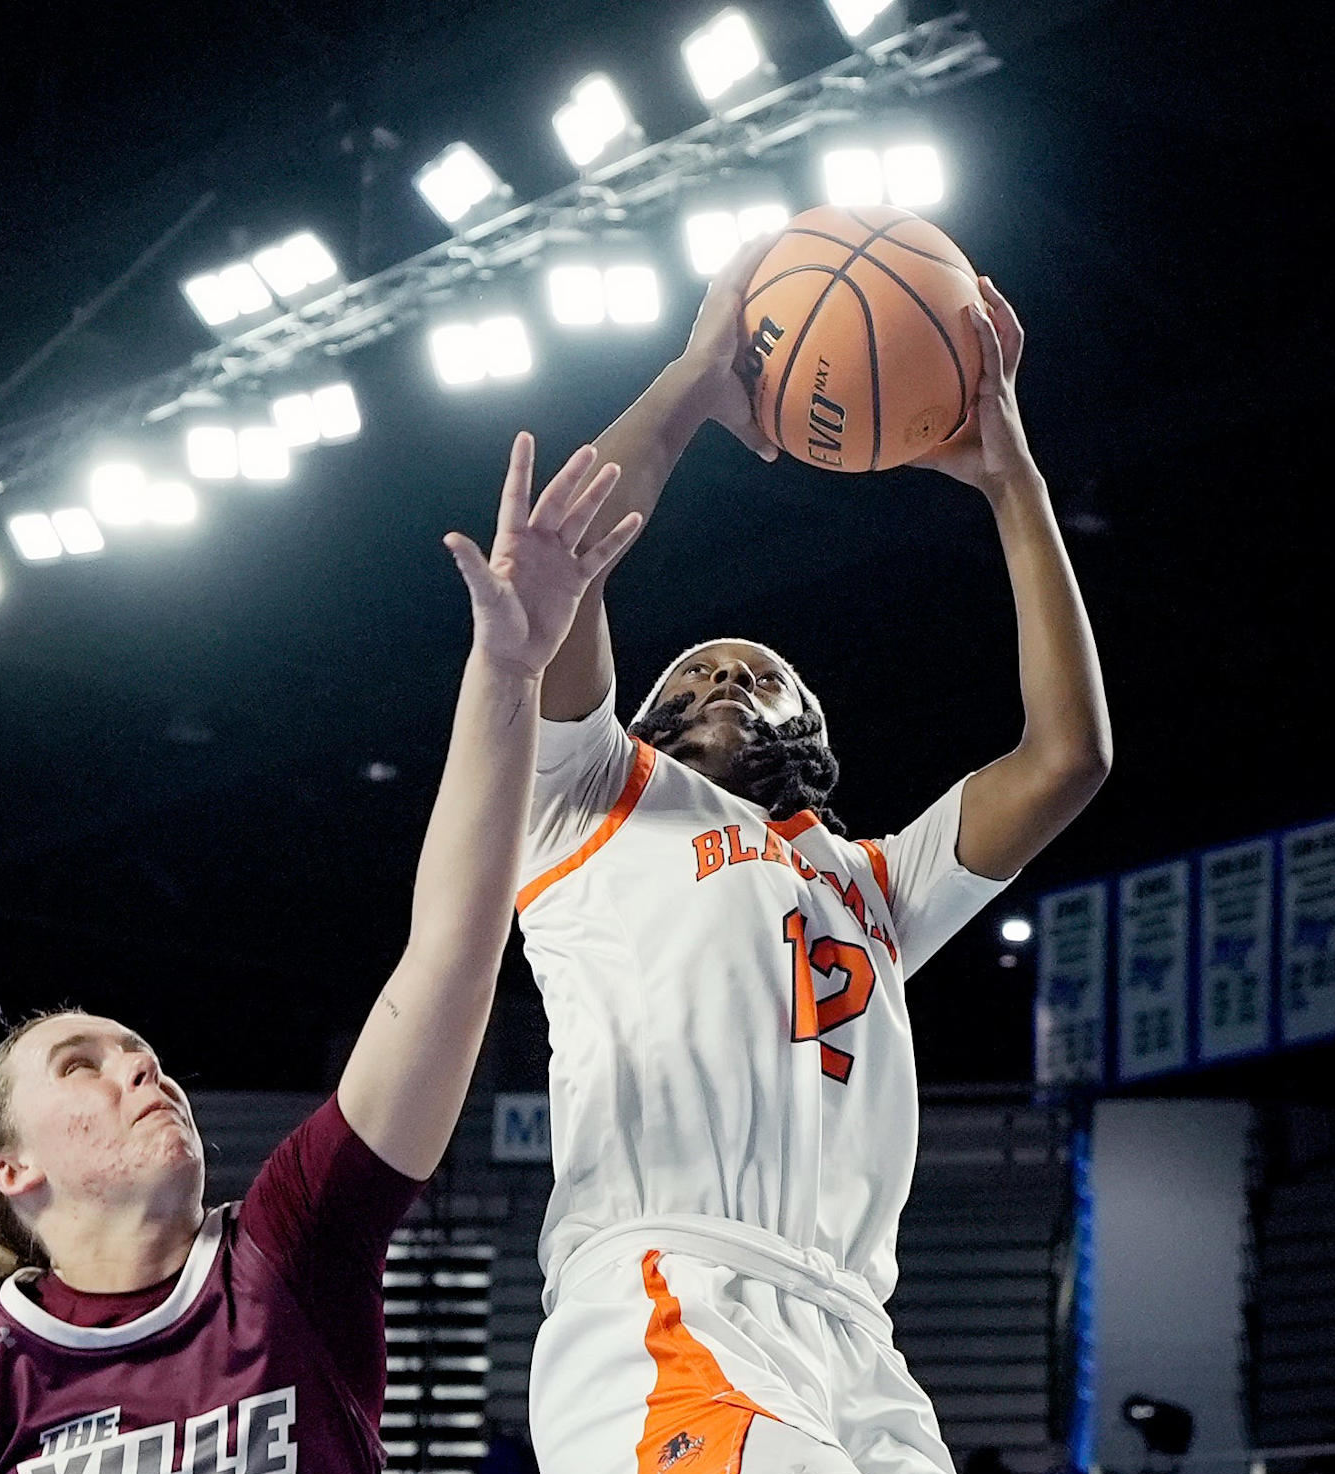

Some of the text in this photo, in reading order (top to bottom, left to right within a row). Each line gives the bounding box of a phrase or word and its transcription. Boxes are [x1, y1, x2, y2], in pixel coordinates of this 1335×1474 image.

[808, 354, 847, 467] EVO NXT
[783, 906, 877, 1085] 12
[40, 1406, 121, 1456] THE
